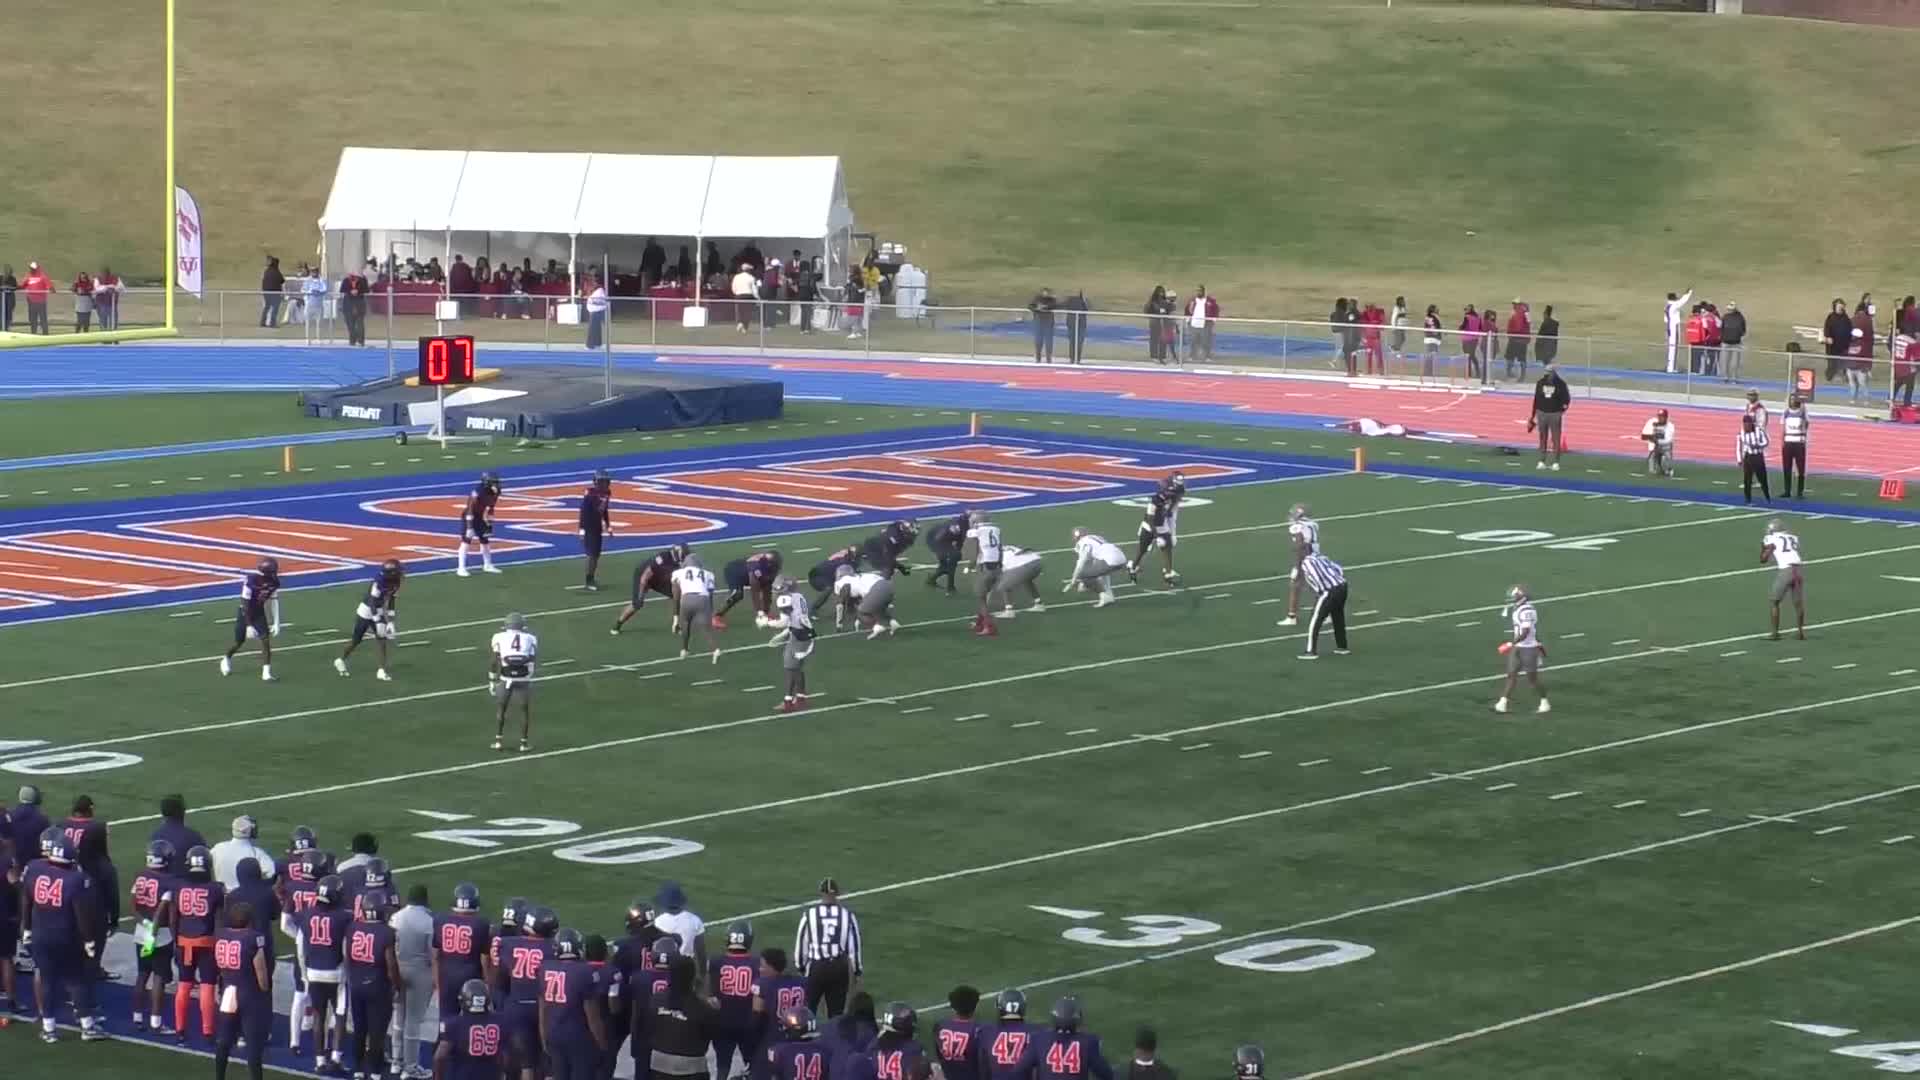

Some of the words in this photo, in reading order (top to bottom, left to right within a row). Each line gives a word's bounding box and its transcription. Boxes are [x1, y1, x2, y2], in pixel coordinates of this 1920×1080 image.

[427, 339, 472, 382] 07
[1797, 370, 1812, 391] 3
[1884, 479, 1898, 496] 10
[685, 569, 705, 584] 44
[510, 633, 522, 652] 4
[33, 875, 63, 907] 64
[134, 876, 159, 908] 23
[178, 887, 210, 916] 85
[309, 915, 333, 947] 11
[441, 923, 473, 955] 86
[729, 931, 745, 944] 20
[821, 917, 838, 943] F
[351, 930, 376, 964] 21
[512, 946, 544, 980] 76
[544, 970, 568, 1004] 71
[719, 964, 753, 997] 20
[1005, 1001, 1020, 1014] 47
[468, 1022, 501, 1057] 69
[938, 1028, 970, 1061] 37
[991, 1031, 1027, 1065] 47
[794, 1051, 823, 1080] 14
[876, 1049, 904, 1080] 14
[1046, 1040, 1081, 1074] 44
